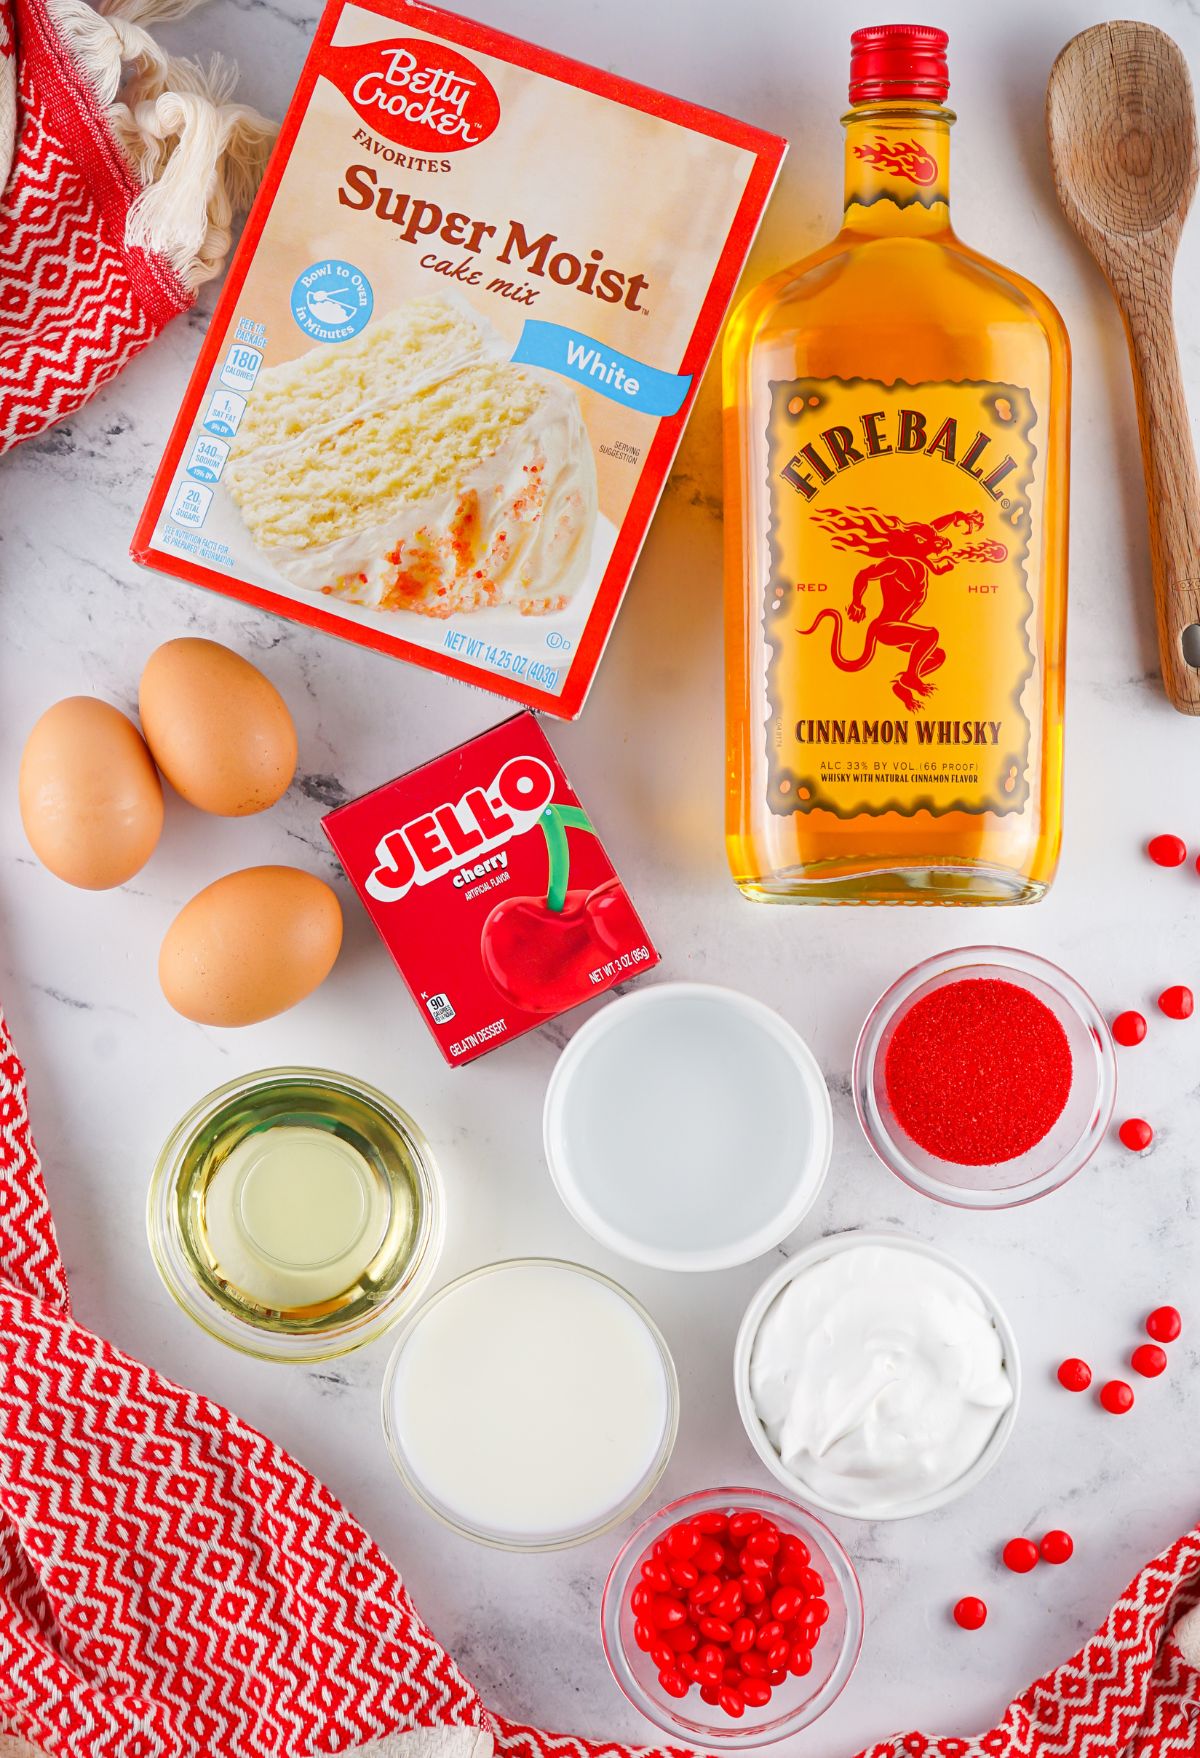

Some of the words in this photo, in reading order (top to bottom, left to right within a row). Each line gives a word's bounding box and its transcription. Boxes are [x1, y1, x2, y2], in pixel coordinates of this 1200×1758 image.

[381, 48, 477, 116] Betty
[353, 72, 479, 142] Crocker
[352, 128, 452, 173] FAVORITES
[338, 164, 496, 254] Super
[497, 220, 650, 312] Moist
[301, 263, 332, 288] Bowl
[336, 266, 350, 278] to
[351, 274, 368, 307] Oven
[420, 253, 484, 285] cake
[485, 278, 541, 306] mix
[239, 317, 255, 332] PER
[296, 306, 307, 321] in
[304, 318, 355, 339] Minutes
[235, 329, 268, 348] PACKAGE
[224, 365, 254, 381] CALORIES
[232, 349, 259, 372] 180
[566, 340, 640, 395] White
[212, 408, 225, 419] SAT
[225, 413, 237, 424] FAT
[598, 444, 638, 464] SUGGESTION
[613, 440, 641, 457] SERVING
[778, 408, 1019, 503] FIREBALL
[195, 454, 221, 469] SODIUM
[175, 508, 201, 523] SUGARS
[182, 501, 200, 514] TOTAL
[796, 583, 828, 593] RED
[967, 585, 999, 594] HOT
[443, 630, 468, 651] NET
[465, 639, 486, 659] WT
[483, 645, 514, 670] 14.25
[511, 654, 529, 675] OZ
[525, 660, 561, 690] (403g)
[795, 719, 909, 745] CINNAMON
[915, 720, 1002, 746] WHISKY
[820, 773, 851, 783] WHISKY
[852, 773, 874, 783] WITH
[874, 774, 910, 783] NATURAL
[910, 774, 950, 784] CINNAMON
[951, 774, 979, 784] FLAVOR
[873, 761, 888, 771] BY
[942, 763, 979, 771] PROOF)
[364, 755, 555, 902] JELL-O
[452, 850, 508, 889] cherry
[464, 881, 492, 902] ARTIFICIAL
[489, 871, 511, 888] FLAVOR
[588, 967, 605, 985] NET
[601, 961, 617, 977] WT
[614, 959, 623, 971] 3
[620, 953, 633, 968] OZ
[630, 945, 650, 964] (85g)
[420, 991, 429, 1000] K
[430, 995, 445, 1010] 90
[449, 1033, 480, 1057] GELATIN
[477, 1018, 508, 1043] DESSERT
